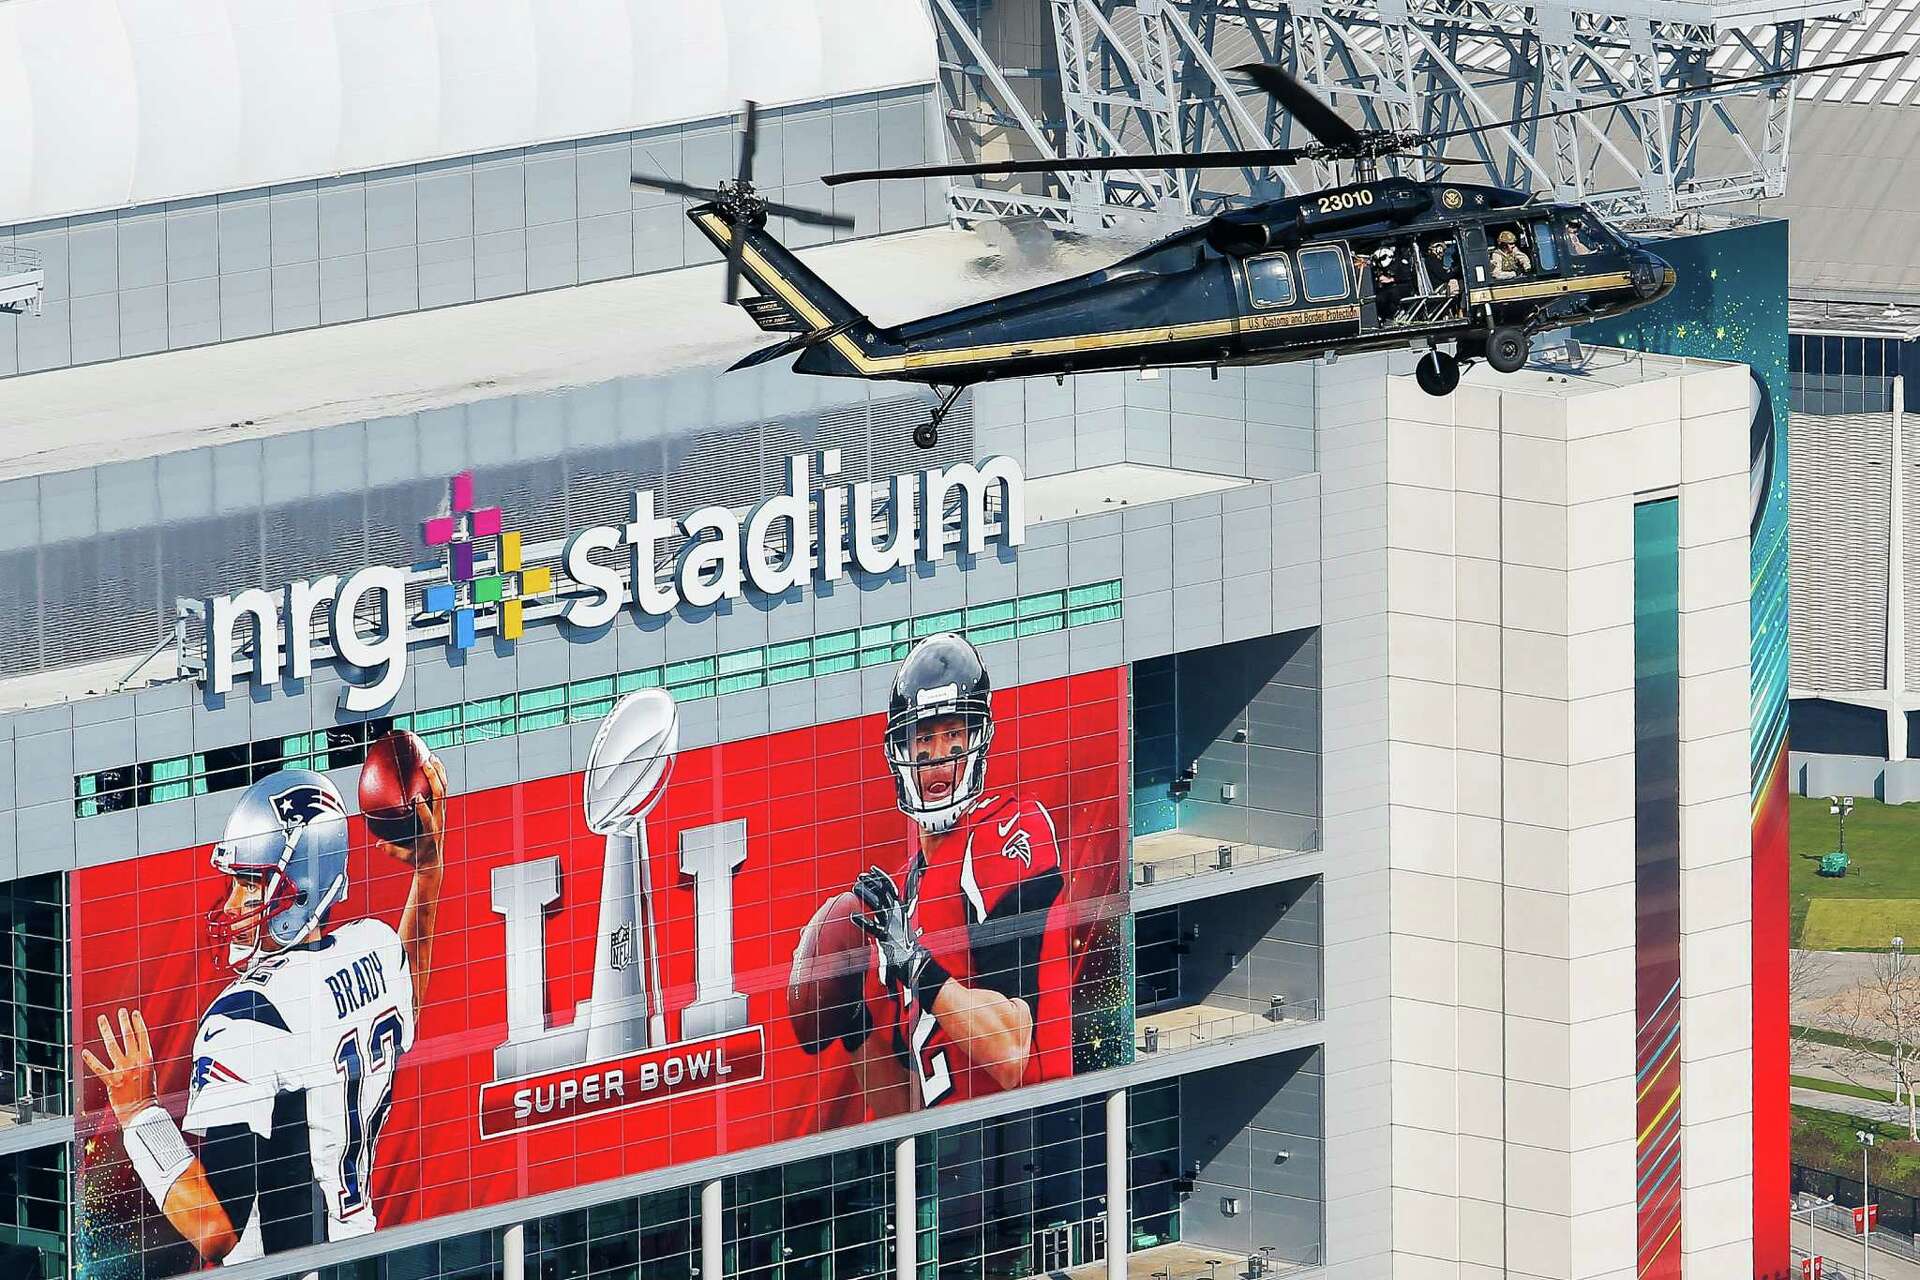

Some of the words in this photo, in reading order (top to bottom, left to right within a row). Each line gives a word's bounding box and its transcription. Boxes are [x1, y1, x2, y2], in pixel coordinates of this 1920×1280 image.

[1317, 189, 1374, 214] 23010
[1248, 317, 1260, 329] U.S.
[1262, 314, 1289, 327] Customs
[1291, 312, 1302, 324] and
[1304, 311, 1325, 323] Border
[1326, 307, 1358, 321] Protection
[211, 565, 408, 712] nrg
[564, 448, 1026, 628] stadium
[612, 942, 629, 966] NFL
[325, 951, 387, 1020] BRADY
[513, 1069, 625, 1119] SUPER
[640, 1048, 732, 1092] BOWL
